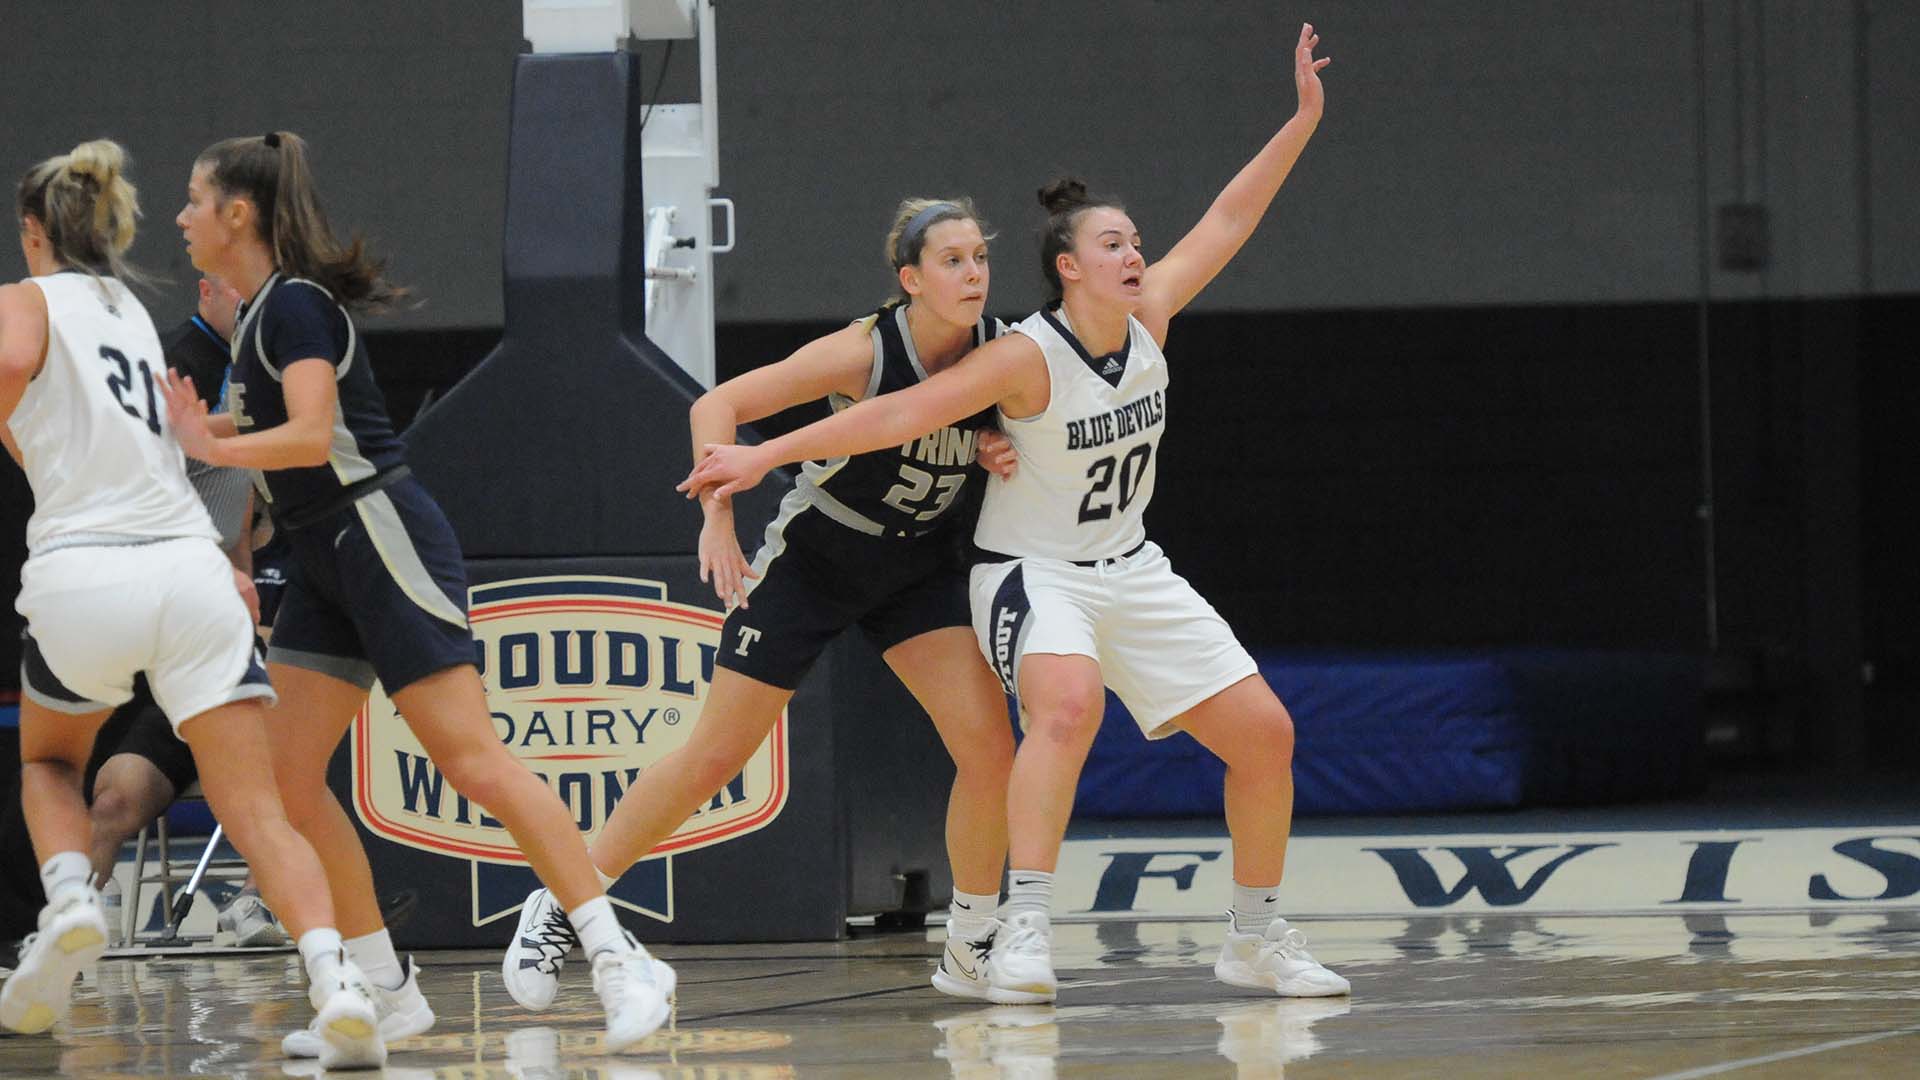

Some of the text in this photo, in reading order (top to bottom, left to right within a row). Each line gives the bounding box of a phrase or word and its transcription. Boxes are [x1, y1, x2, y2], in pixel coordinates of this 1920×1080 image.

[98, 344, 161, 436] 21
[1067, 390, 1162, 450] BLUE DEVILS
[882, 464, 966, 520] 23
[1078, 442, 1152, 525] 20
[472, 630, 717, 695] OUDL
[735, 625, 762, 657] T
[1068, 850, 1223, 914] F
